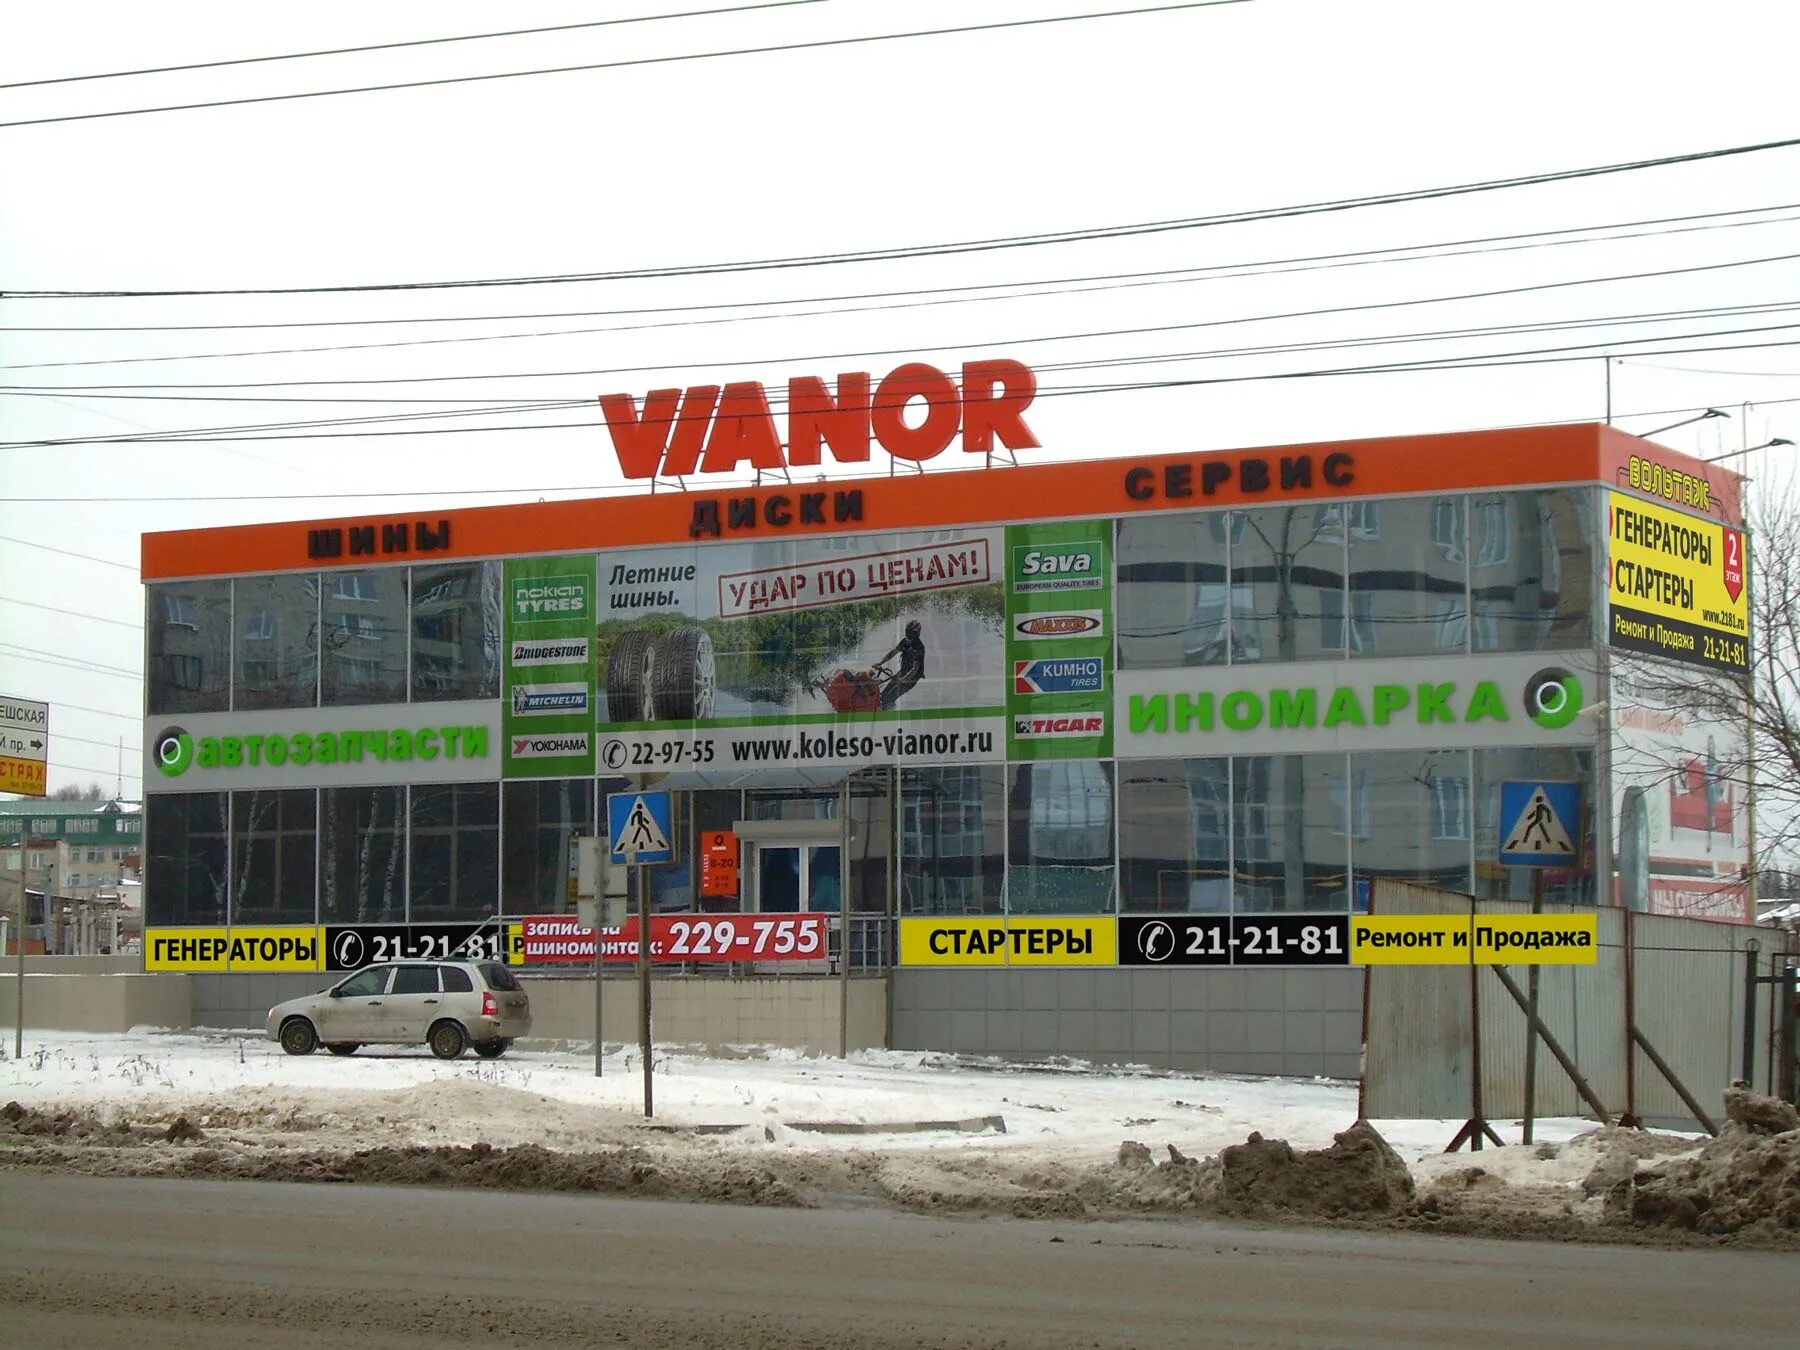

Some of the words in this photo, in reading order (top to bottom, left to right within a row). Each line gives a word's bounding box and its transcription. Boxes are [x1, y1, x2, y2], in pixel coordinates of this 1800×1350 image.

[598, 358, 1042, 480] VIANOR
[1125, 453, 1355, 501] СЕРВИС
[689, 490, 862, 537] ДИСКИ
[308, 520, 449, 559] ШИНЫ
[1616, 507, 1712, 566] ГЕНЕРАТОРЫ
[1728, 533, 1737, 567] 2
[609, 564, 696, 586] Летние
[1022, 551, 1092, 576] Sava
[729, 575, 807, 609] УДАР
[817, 568, 855, 596] ПО
[867, 550, 979, 590] ЦЕНАМ!
[1016, 583, 1052, 592] EUROPEAN
[1053, 580, 1081, 589] QUALITY
[1615, 559, 1693, 610] СТАРТЕРЫ
[516, 597, 584, 614] TYRES
[610, 590, 680, 609] шины.
[1030, 618, 1087, 633] MAXXIS
[1615, 614, 1648, 639] Ремонт
[1649, 625, 1655, 638] и
[1656, 626, 1694, 651] Продажа
[1703, 608, 1745, 631] www.2181.ru
[513, 645, 587, 660] BRIDGESTONE
[1703, 635, 1746, 666] 21-21-81
[1043, 662, 1097, 677] KUMHO
[1070, 678, 1098, 687] TIRES
[528, 695, 584, 706] MICHELIN
[1128, 680, 1509, 734] ИНОМАРКА
[1033, 718, 1102, 734] TIGAR
[196, 725, 488, 769] автозапчасти
[530, 738, 587, 752] YOKOHAMA
[631, 740, 715, 765] 22-97-55
[732, 728, 993, 762] www.koleso-vianor.ru
[155, 938, 316, 961] ГЕНЕРАТОРЫ
[373, 935, 500, 962] 21-21-81
[669, 920, 819, 955] 229-755
[929, 928, 1092, 955] СТАРТЕРЫ
[1185, 926, 1342, 955] 21-21-81
[1356, 928, 1445, 948] Ремонт
[1453, 934, 1468, 948] и
[1476, 927, 1591, 949] Продажа
